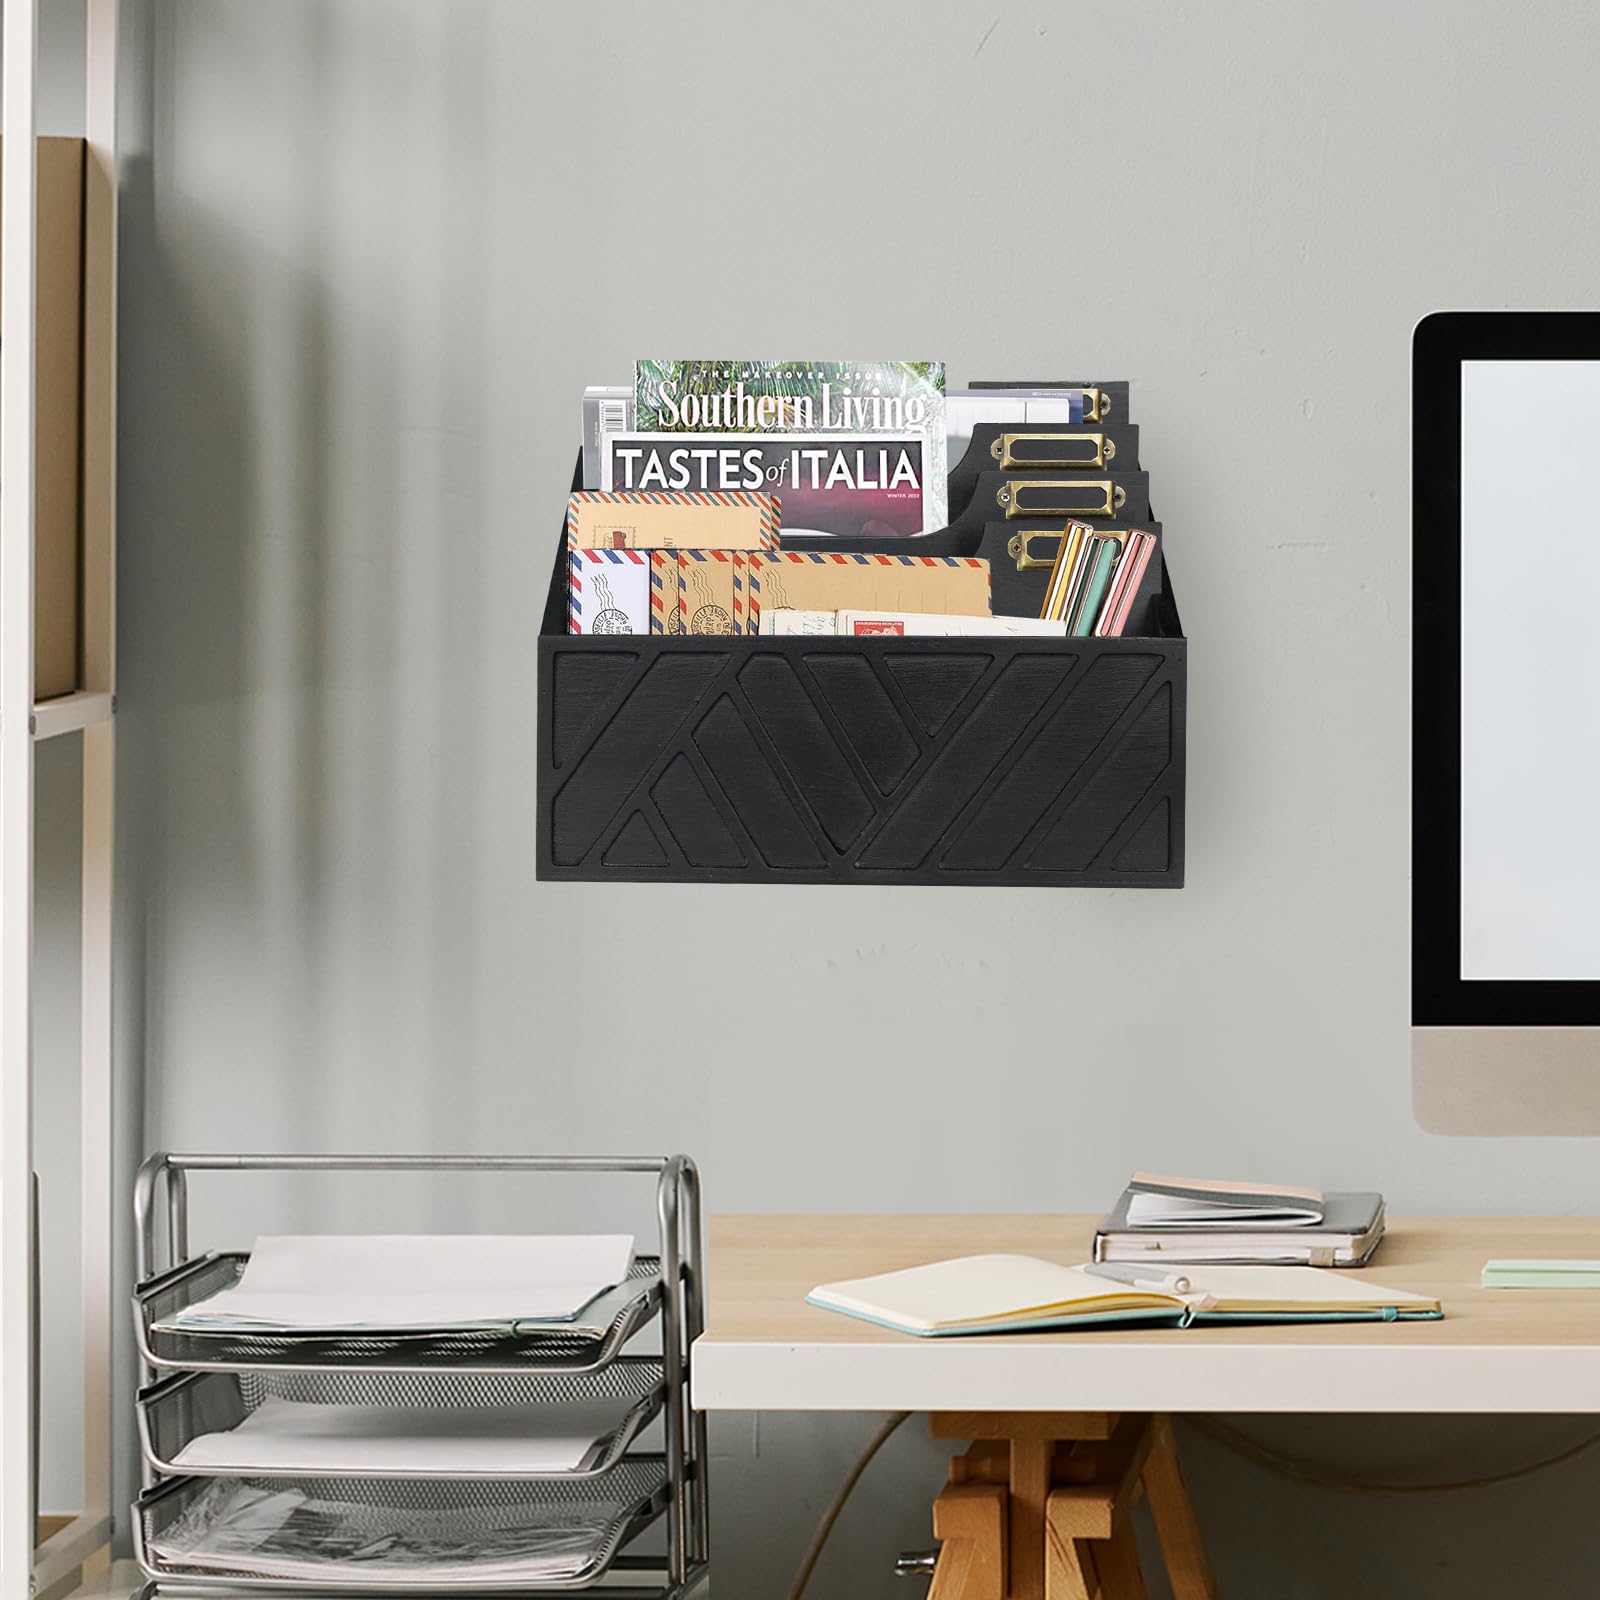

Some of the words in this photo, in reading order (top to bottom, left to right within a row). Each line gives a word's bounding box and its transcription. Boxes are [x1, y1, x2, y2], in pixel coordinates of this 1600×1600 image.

[701, 370, 730, 379] THE
[741, 370, 825, 380] MAKEOVER
[836, 372, 882, 381] ISSUE
[658, 380, 813, 429] Southern
[821, 382, 927, 434] Living
[615, 449, 764, 489] TASTES
[765, 458, 790, 488] of
[791, 449, 921, 490] ITALIA
